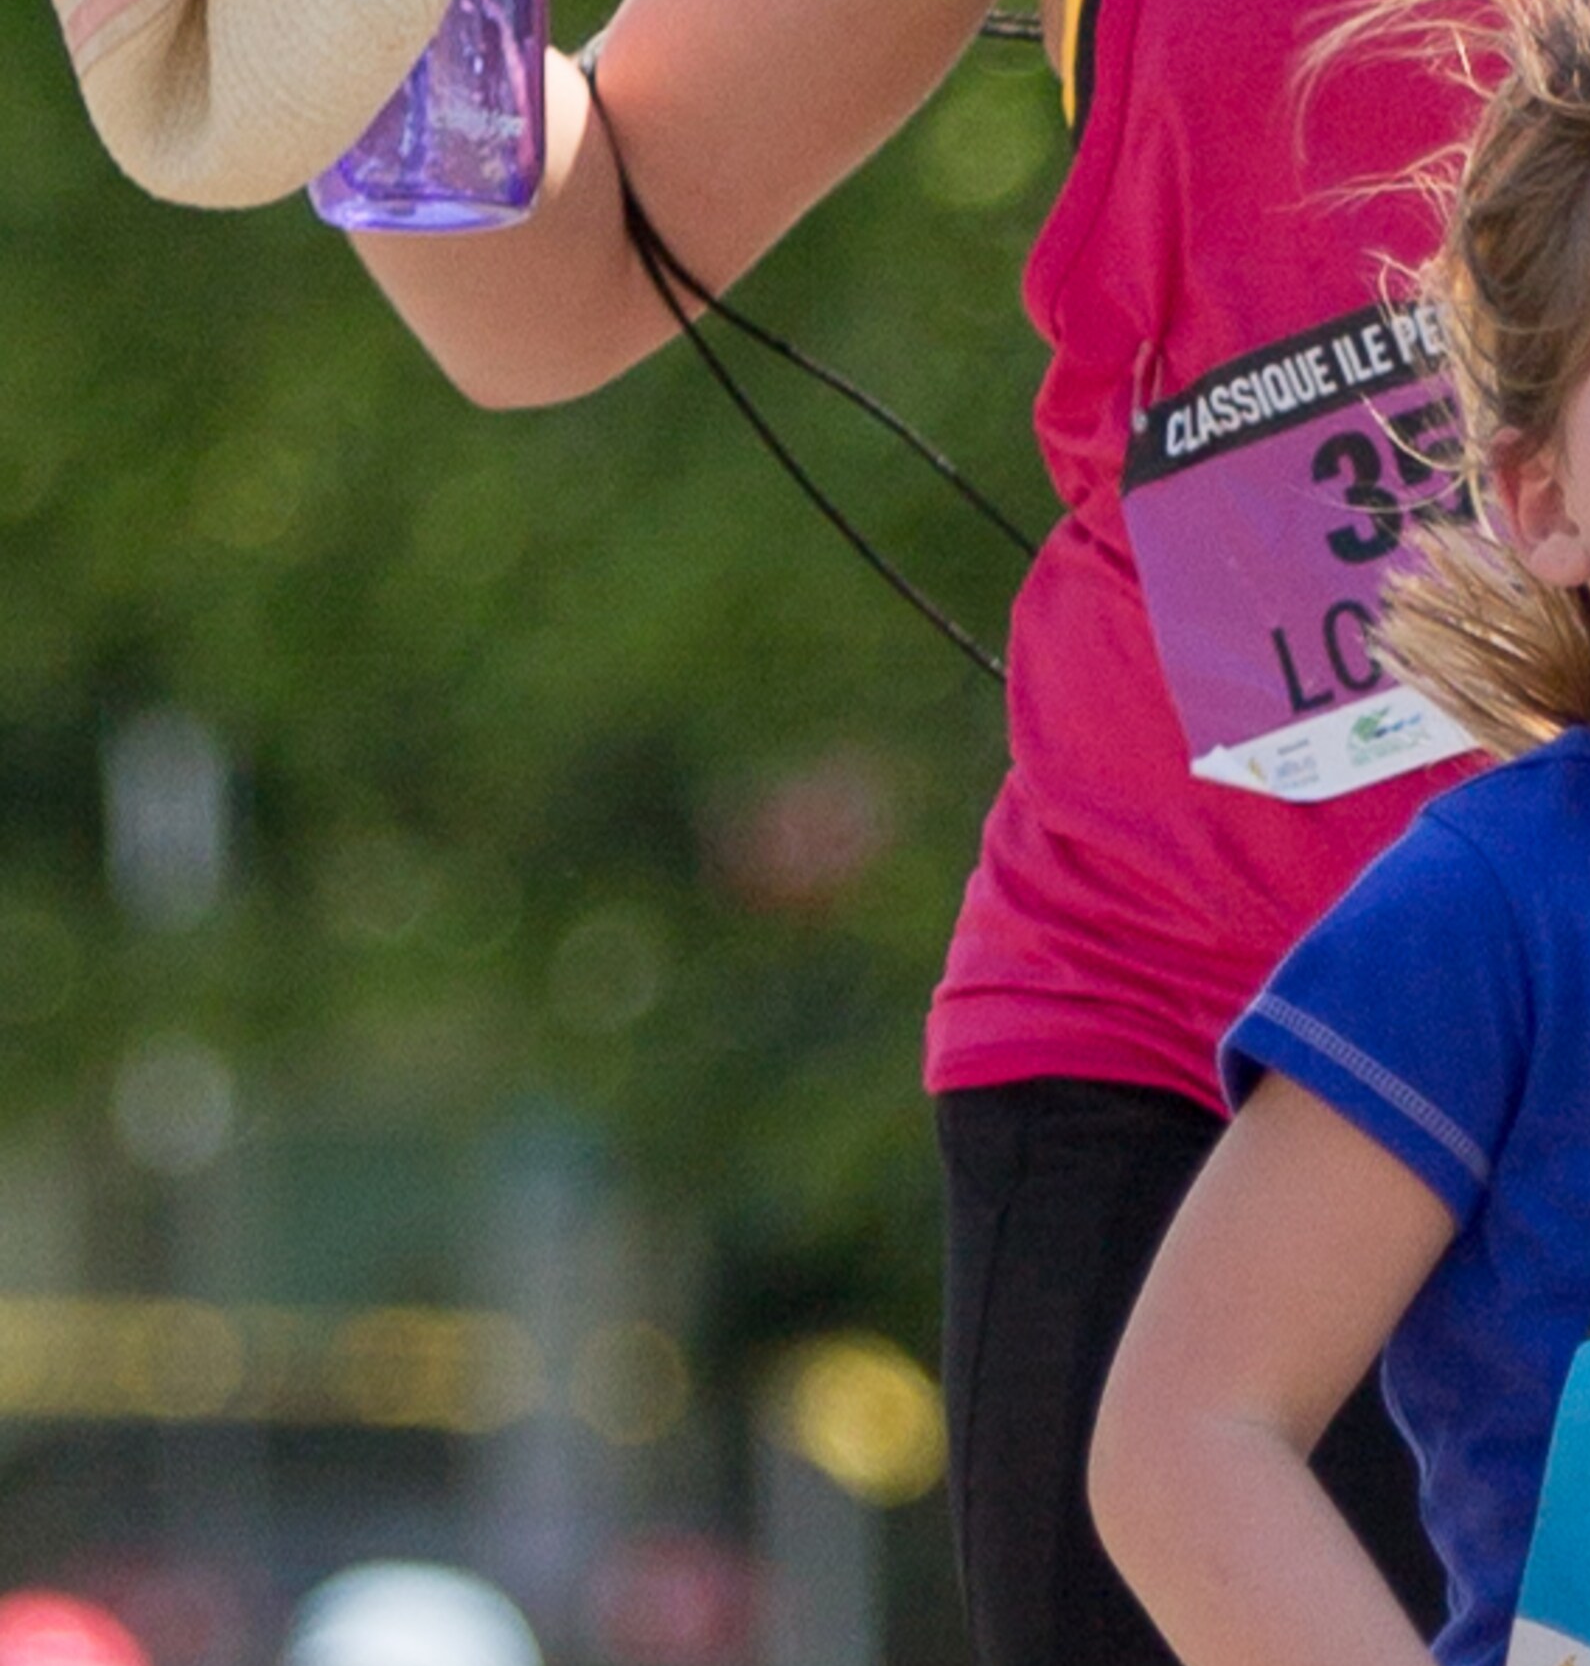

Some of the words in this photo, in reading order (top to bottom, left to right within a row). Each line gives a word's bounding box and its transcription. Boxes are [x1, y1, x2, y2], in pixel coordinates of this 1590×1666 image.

[1165, 345, 1338, 458] CLASSIQUE
[1331, 324, 1394, 386] ILE
[1391, 304, 1441, 364] PE
[1271, 598, 1385, 713] LO
